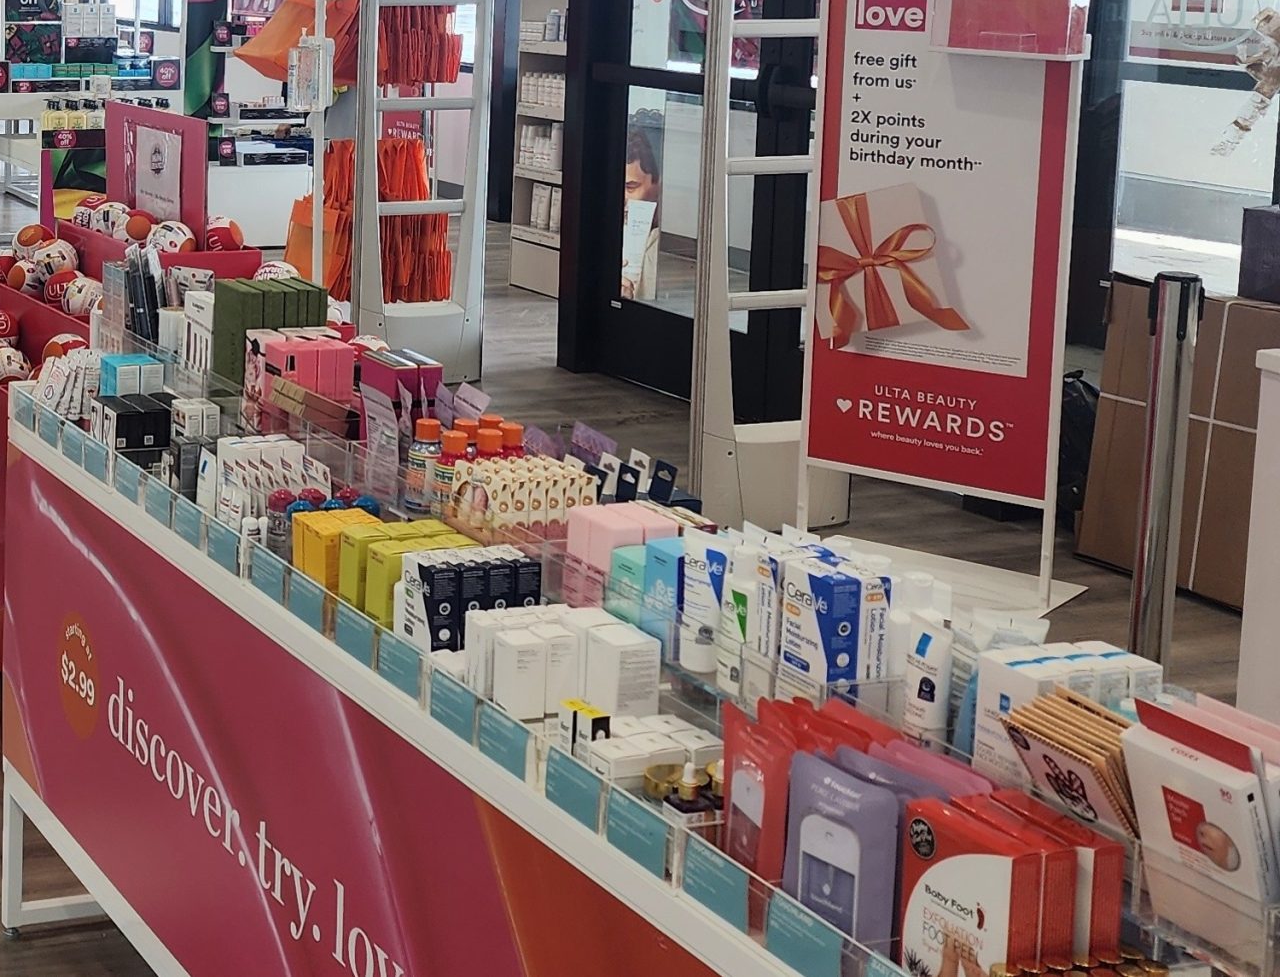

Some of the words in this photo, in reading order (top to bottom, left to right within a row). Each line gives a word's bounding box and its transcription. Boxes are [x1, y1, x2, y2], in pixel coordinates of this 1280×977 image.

[854, 52, 884, 67] free
[889, 53, 917, 70] gift
[853, 73, 890, 88] from
[851, 111, 871, 124] 2X
[876, 112, 925, 129] points
[850, 130, 899, 148] during
[905, 137, 942, 151] your
[849, 148, 916, 169] birthday
[49, 283, 68, 295] ULT
[875, 384, 910, 401] ULTA
[917, 391, 977, 411] BEAUTY
[871, 430, 894, 441] where
[896, 433, 922, 447] beauty
[923, 439, 943, 450] loves
[945, 443, 960, 453] you
[404, 570, 431, 597] CeraVe
[787, 582, 828, 615] CeraVe
[64, 624, 88, 649] starting
[61, 650, 96, 707] $2.99
[924, 884, 949, 906] Baby
[951, 899, 974, 919] Foot
[922, 907, 983, 950] EXFOLIATION
[922, 921, 949, 948] FOOT
